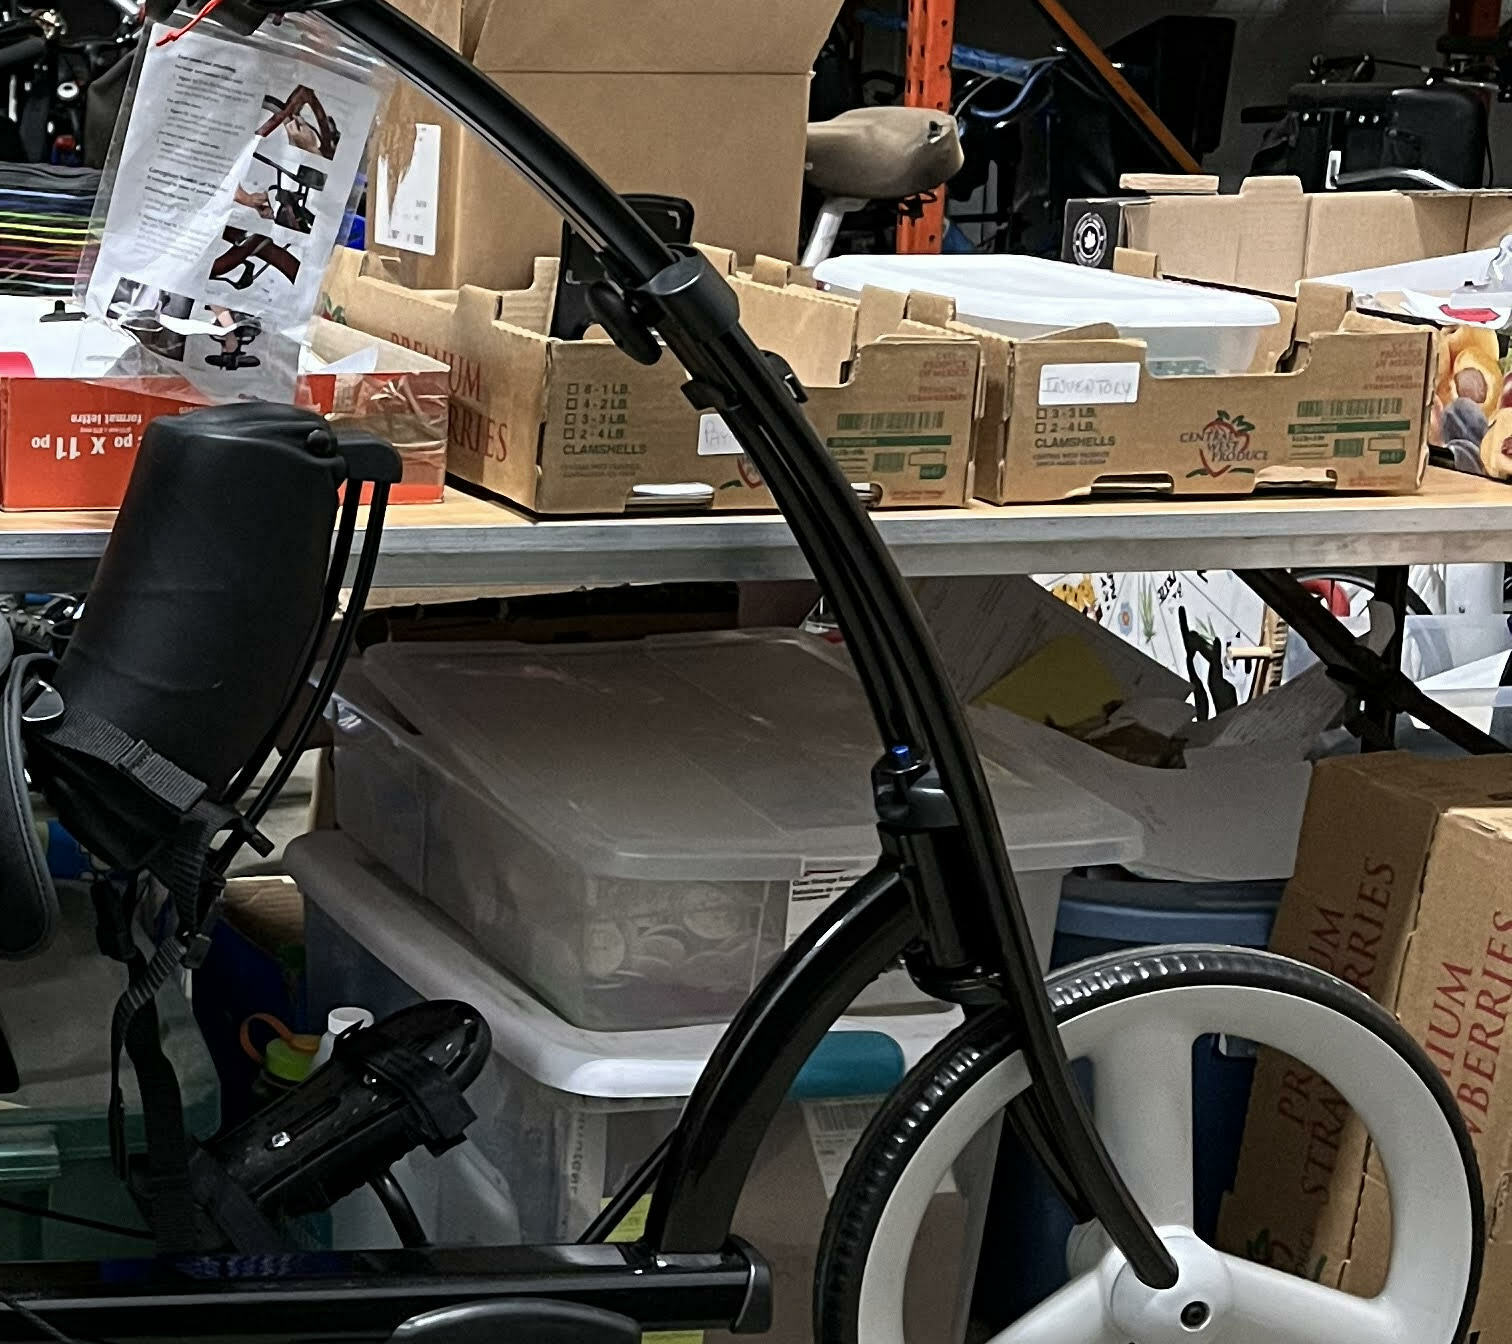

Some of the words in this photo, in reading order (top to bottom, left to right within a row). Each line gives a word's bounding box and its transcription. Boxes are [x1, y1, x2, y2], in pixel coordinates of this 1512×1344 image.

[70, 413, 102, 424] lettre
[104, 413, 142, 424] format
[31, 435, 51, 449] po
[113, 434, 133, 449] po
[1034, 436, 1116, 448] CLAMSHELLS
[56, 436, 81, 460] 11
[563, 444, 648, 456] CLAMSHELLS
